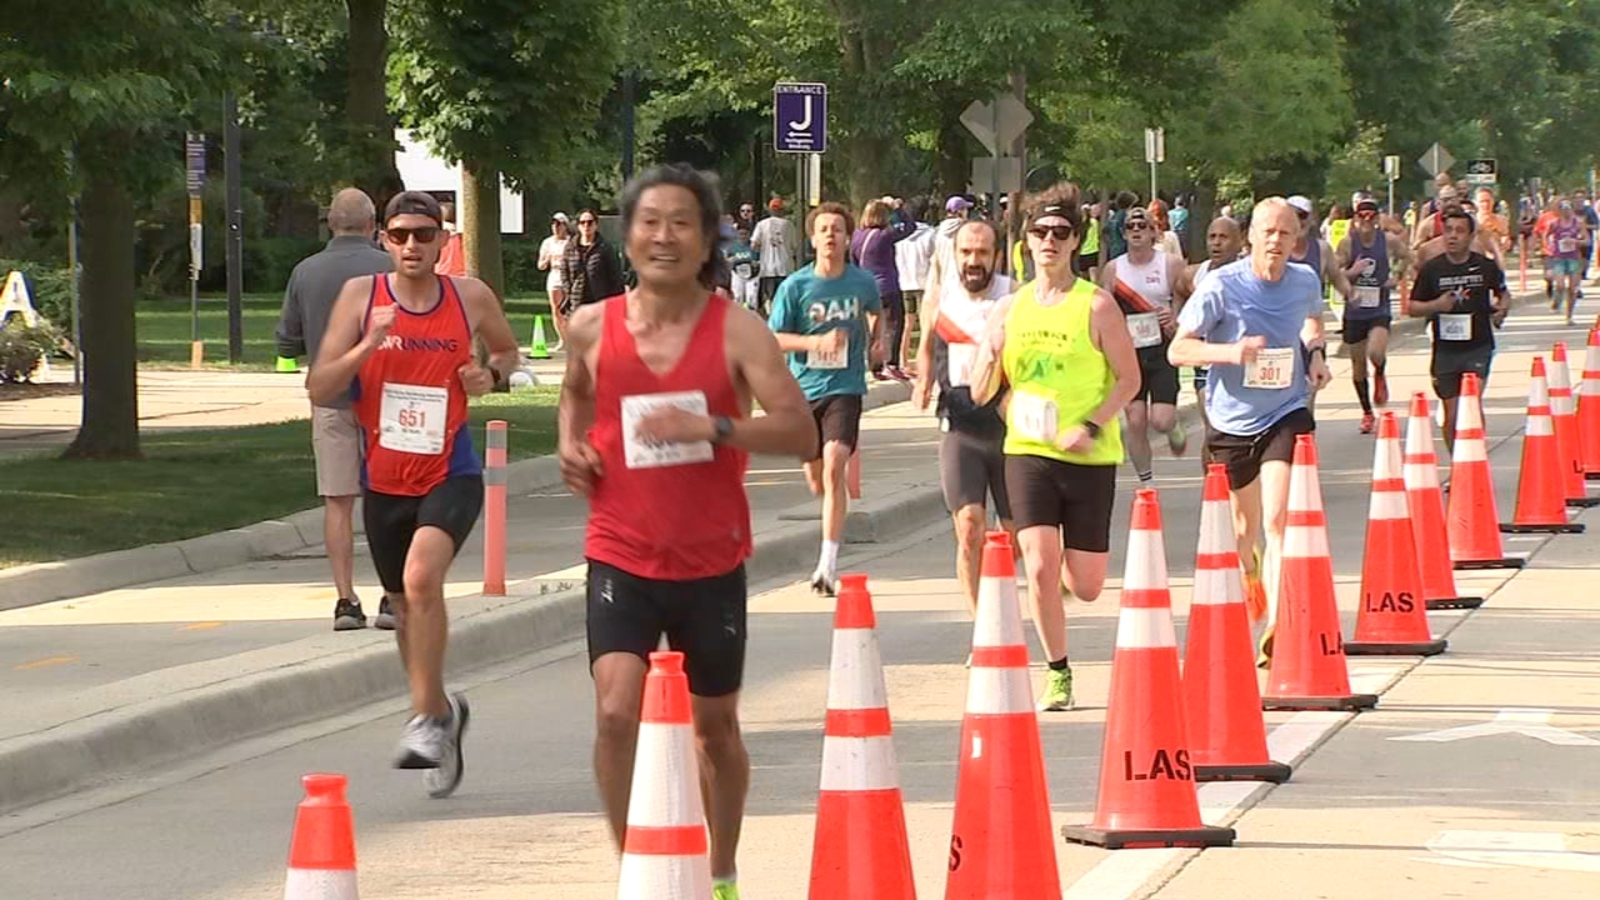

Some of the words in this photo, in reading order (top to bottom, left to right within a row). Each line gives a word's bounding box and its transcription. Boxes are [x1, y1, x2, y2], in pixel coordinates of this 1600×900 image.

[788, 94, 812, 131] J
[378, 334, 459, 352] WRUNNING
[1259, 366, 1281, 381] 301
[398, 408, 426, 429] 651
[1366, 592, 1414, 613] LAS
[1124, 749, 1191, 781] LAS
